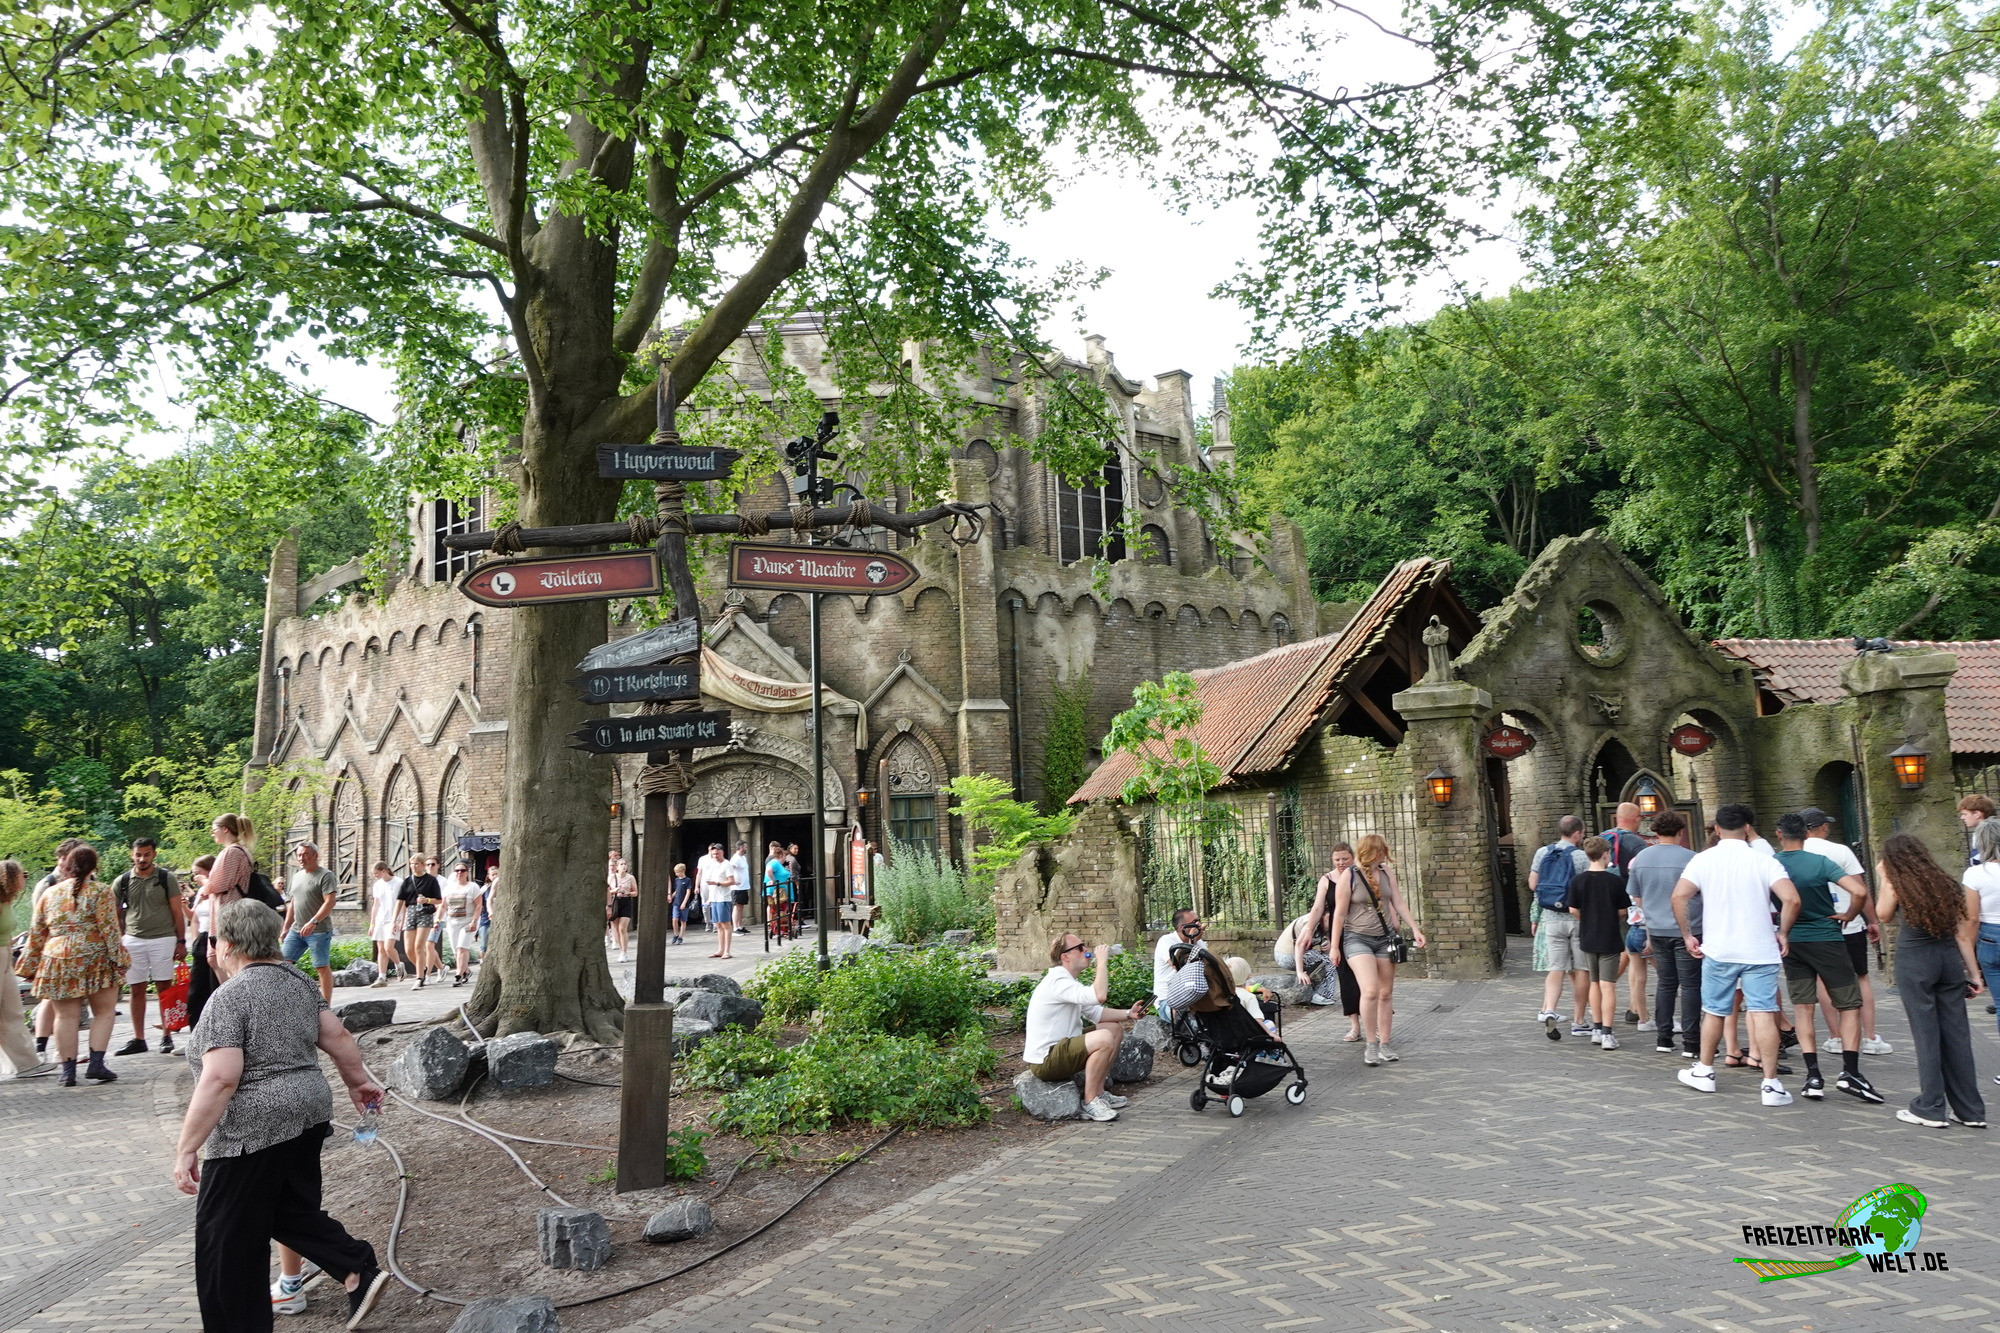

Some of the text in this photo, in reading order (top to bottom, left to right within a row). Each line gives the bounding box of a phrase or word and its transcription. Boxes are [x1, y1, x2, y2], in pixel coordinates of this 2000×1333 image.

[613, 451, 716, 475] Huyverwoud
[538, 566, 603, 589] Toiletten
[751, 556, 857, 579] Danse Macabre
[746, 680, 798, 698] Charlatans
[635, 725, 656, 742] den
[656, 722, 696, 741] Swarte
[697, 719, 718, 739] Kat
